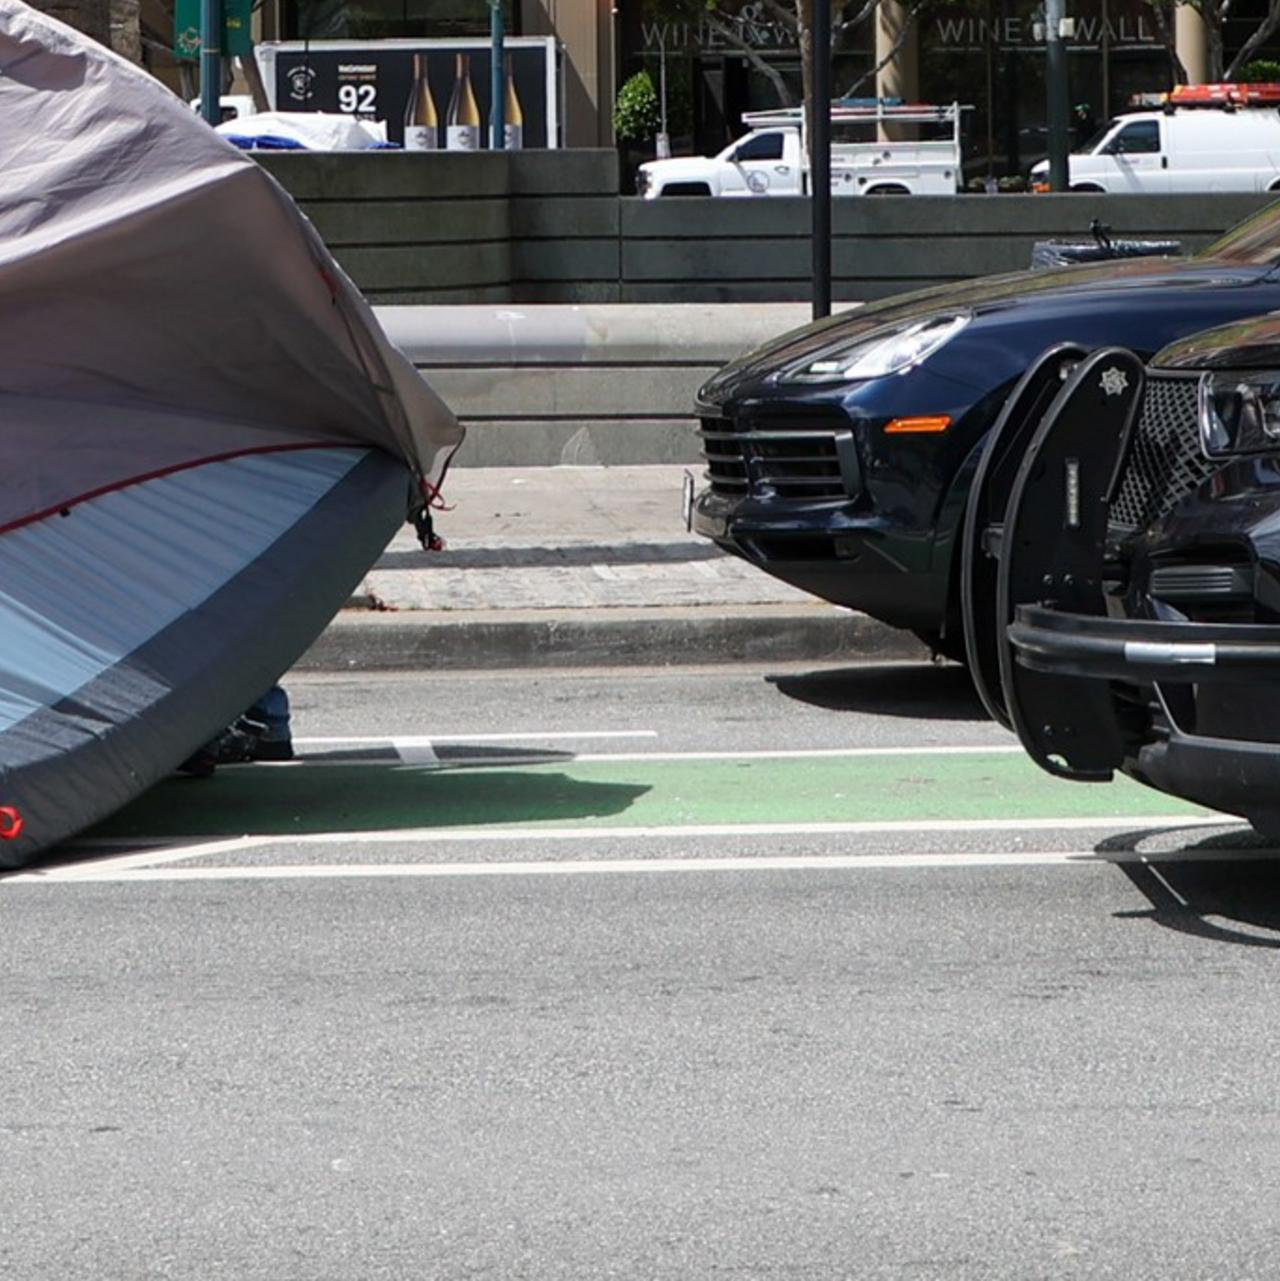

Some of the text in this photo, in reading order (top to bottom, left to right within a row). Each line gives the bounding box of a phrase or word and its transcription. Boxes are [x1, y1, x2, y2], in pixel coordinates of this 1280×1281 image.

[640, 22, 726, 47] WINE
[936, 16, 1155, 43] WINE WALL
[338, 84, 377, 113] 92
